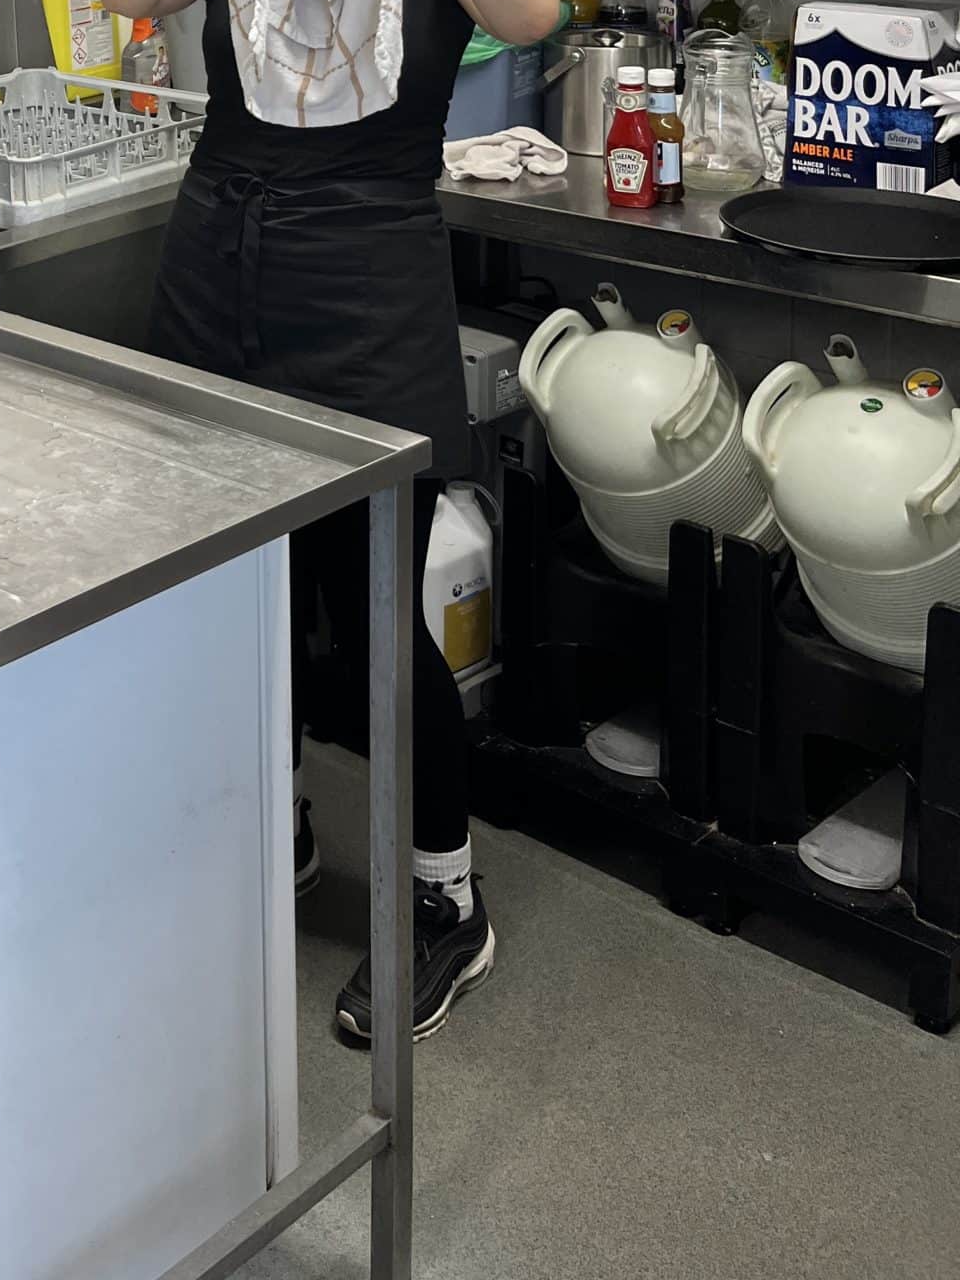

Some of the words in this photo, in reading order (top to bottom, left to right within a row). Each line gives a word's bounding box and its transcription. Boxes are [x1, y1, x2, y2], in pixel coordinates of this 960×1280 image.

[807, 12, 822, 24] 6x
[794, 56, 923, 110] DOOM
[793, 98, 875, 148] BAR
[616, 153, 637, 161] HEINZ
[792, 141, 830, 159] AMBER
[832, 147, 854, 161] ALE
[615, 162, 640, 170] TOMATO
[792, 158, 824, 169] BALANCED
